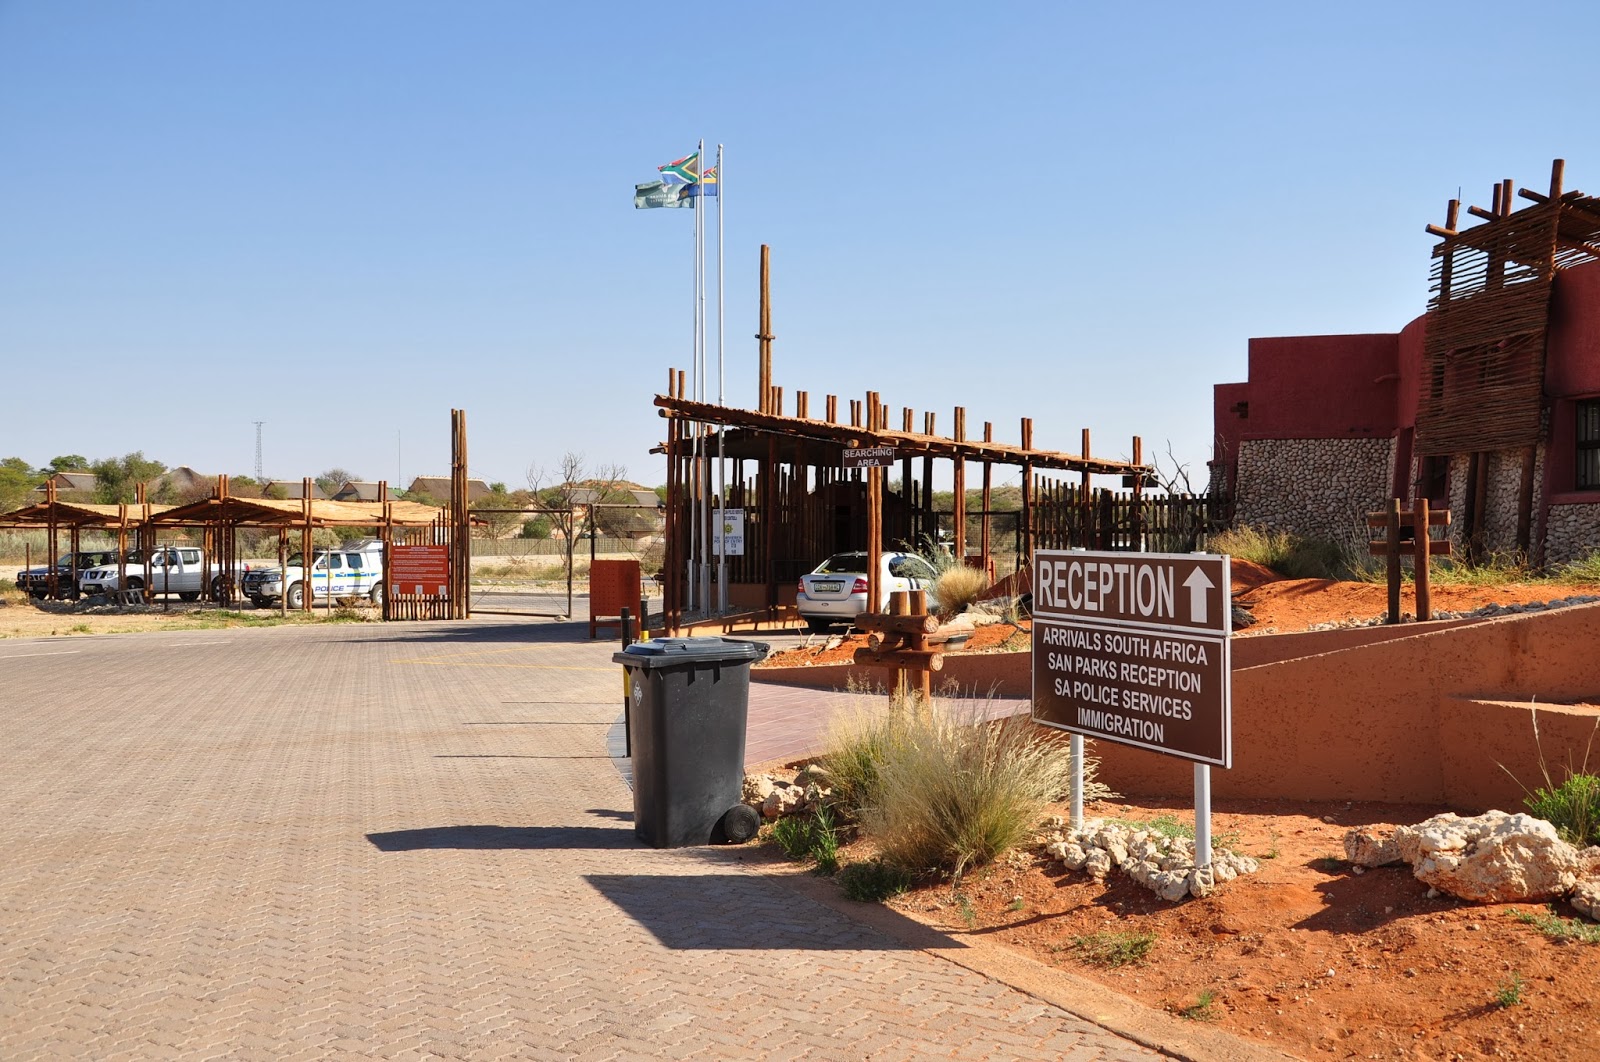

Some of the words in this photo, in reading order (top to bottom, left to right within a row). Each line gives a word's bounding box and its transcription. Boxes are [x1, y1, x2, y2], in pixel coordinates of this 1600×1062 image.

[844, 448, 892, 458] SEARCHING
[857, 459, 880, 467] AREA
[1039, 560, 1175, 618] RECEPTION
[1042, 627, 1101, 651] ARRIVALS
[1104, 633, 1149, 658] SOUTH
[1153, 640, 1208, 666] AFRICA
[1048, 652, 1072, 673] SAN
[1075, 656, 1117, 682] PARKS
[1120, 663, 1201, 694] RECEPTION
[1055, 678, 1071, 698] SA
[1074, 680, 1119, 707] POLICE
[1122, 690, 1192, 721] SERVICES
[1077, 706, 1164, 743] IMMIGRATION
